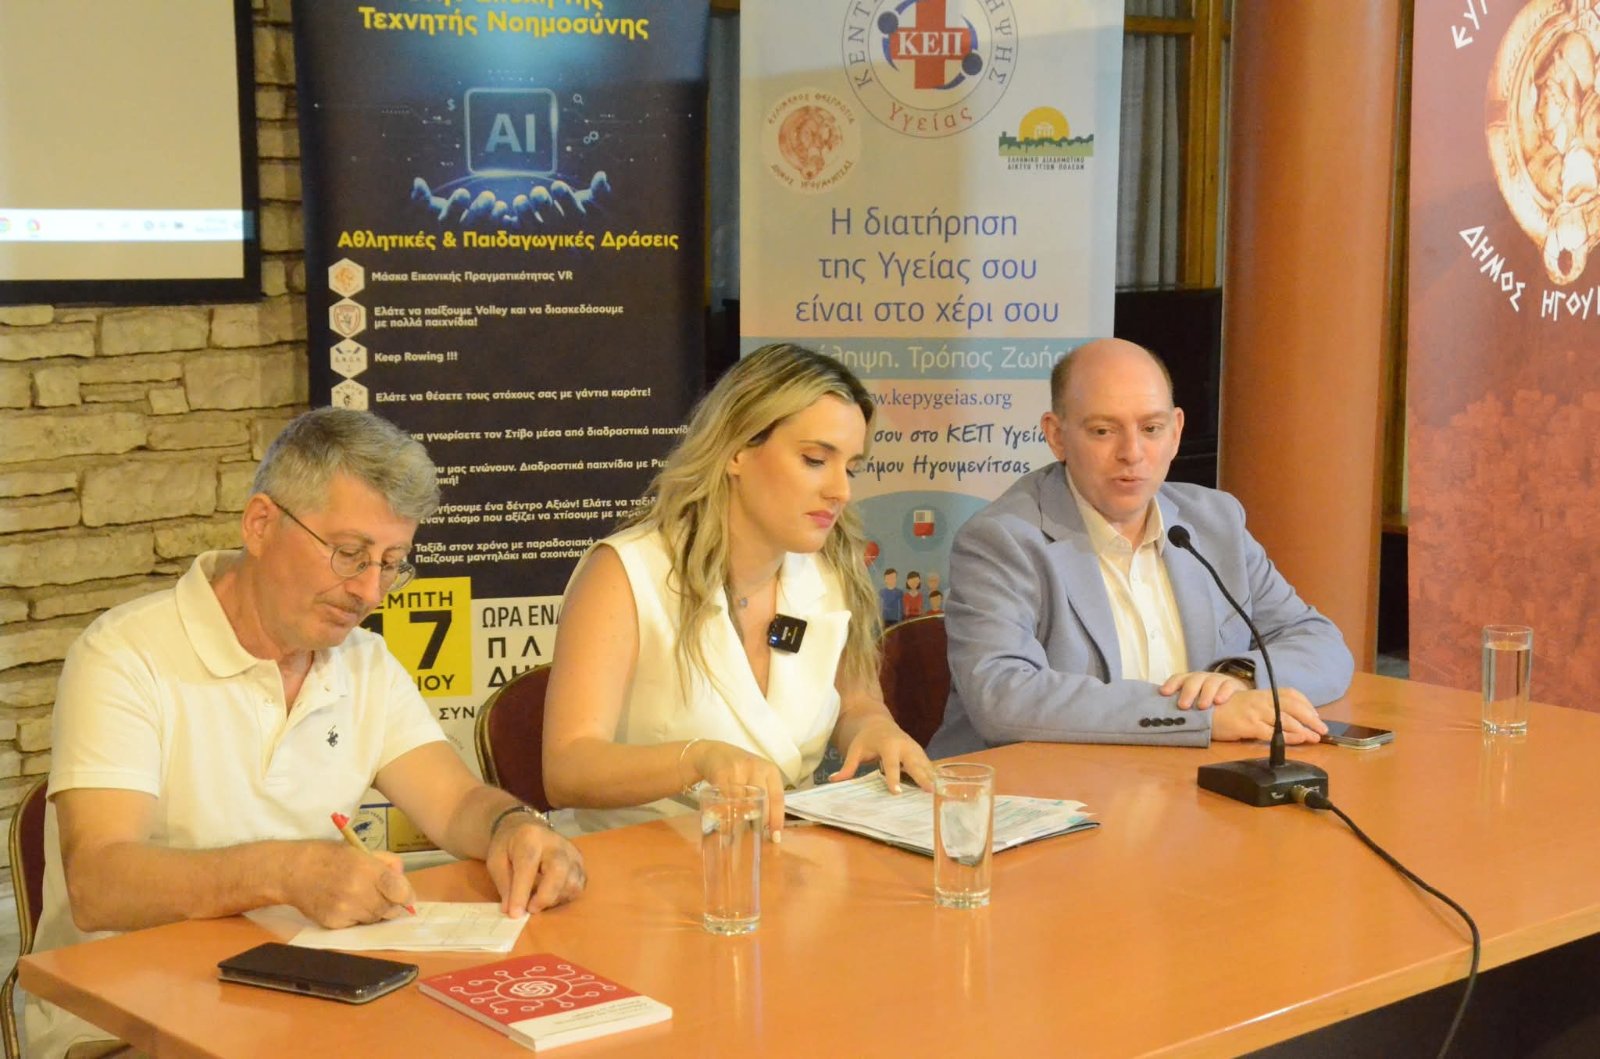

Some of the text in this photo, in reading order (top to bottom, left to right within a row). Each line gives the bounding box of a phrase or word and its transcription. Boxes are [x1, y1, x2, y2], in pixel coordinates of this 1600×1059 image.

[358, 6, 648, 40] Τεχνητής Νοημοσύνης
[847, 0, 881, 91] ΚΕΝΤ
[897, 31, 963, 57] ΚΕΠ
[984, 0, 1013, 84] ΗΨΗΣ
[889, 102, 973, 132] Υγείας
[485, 113, 536, 153] AI
[831, 206, 1018, 243] Η διατήρηση
[337, 230, 680, 252] Αθλητικές & Παιδαγωγικές Δράσεις
[371, 270, 574, 284] Μάσκα Εικονικής Πραγματικότητας VR
[819, 251, 1037, 287] της Υγείας σου
[1459, 225, 1526, 313] ΔΗΜΟΣ
[374, 303, 624, 318] Ελάτε να παίξουμε Volley και να διασκεδάσουμε
[796, 293, 1059, 329] είναι στο χέρι σου
[374, 317, 478, 329] με πολλά παιχνίδια!
[374, 352, 402, 363] Keep
[404, 351, 444, 363] Rowing
[816, 343, 1064, 374] ληψη. Τρόπος Ζωή
[375, 387, 651, 402] Ελάτε να θέσετε τους στόχους σας με γάντια καράτε!
[867, 388, 1013, 410] w.kepygeias.org
[411, 424, 690, 442] να γνωρίσετε τον Στίβο μέσα από διαδραστικά παιχνίδ
[874, 423, 1048, 449] σου στο ΚΕΠ Υγεία
[447, 466, 466, 475] μας
[469, 463, 517, 474] ενώνουν.
[519, 461, 584, 473] Διαδραστικά
[587, 459, 633, 470] παιχνίδια
[636, 460, 648, 470] με
[860, 455, 1031, 482] ήμου Ηγουμενίτσας
[437, 503, 482, 514] γήσουμε
[484, 501, 503, 511] ένα
[506, 500, 542, 512] δέντρο
[545, 499, 580, 510] Αξιών!
[583, 498, 612, 508] Ελάτε
[614, 499, 627, 508] να
[448, 512, 480, 524] κόσμο
[483, 514, 502, 523] που
[505, 511, 535, 523] αξίζει
[538, 512, 551, 521] να
[553, 509, 599, 520] χτίσουμε
[601, 510, 613, 520] με
[415, 542, 446, 553] Ταξίδι
[449, 543, 474, 552] στον
[476, 540, 509, 552] χρόνο
[511, 541, 524, 551] με
[526, 537, 594, 550] παραδοσιακά
[415, 553, 464, 564] Παίζουμε
[467, 551, 519, 563] μαντηλάκι
[522, 551, 537, 560] και
[377, 591, 453, 610] ΜΠΤΗ
[482, 606, 523, 628] ΩΡΑ
[417, 674, 455, 692] ΙΟΥ
[439, 706, 475, 720] ΣΥΝ
